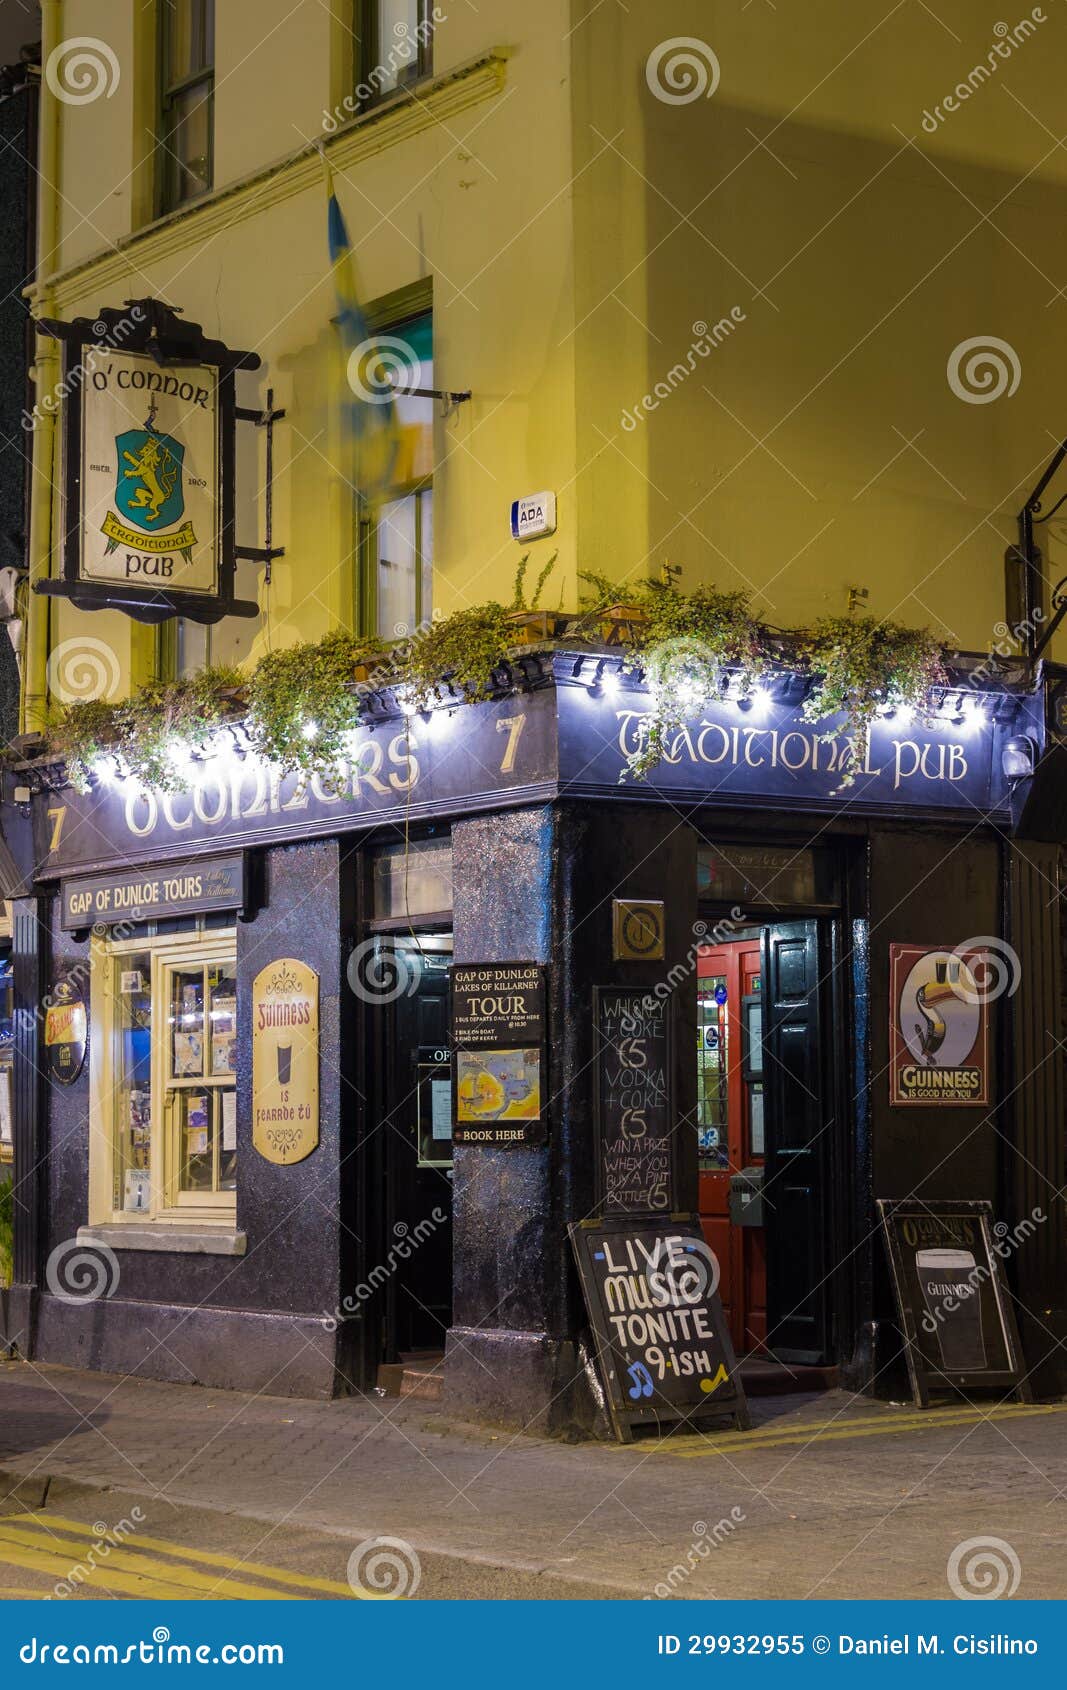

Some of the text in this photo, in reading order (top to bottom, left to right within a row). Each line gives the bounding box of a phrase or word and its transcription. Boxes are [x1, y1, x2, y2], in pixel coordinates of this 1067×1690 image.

[520, 507, 543, 523] ADA
[125, 554, 174, 577] PUB
[891, 739, 968, 790] PUB
[47, 805, 67, 853] 7
[496, 712, 526, 774] 7
[69, 876, 202, 914] GAP OF DUNLOE TOURS
[455, 968, 539, 983] GAP OF DUNLOE
[454, 981, 540, 993] LAKES OF KILLARNEY
[467, 996, 528, 1016] TOUR
[603, 998, 669, 1019] WHISKEY
[620, 1019, 665, 1039] COKE
[605, 1068, 667, 1089] VODKA
[902, 1066, 980, 1089] GUINNESS
[620, 1088, 665, 1110] COKE
[908, 1087, 972, 1098] IS GOOD FOR YOU
[463, 1129, 525, 1141] BOOK HERE
[602, 1138, 631, 1153] WIN
[633, 1138, 642, 1153] A
[604, 1156, 668, 1173] WHEN YOU
[631, 1171, 642, 1185] A
[602, 1235, 687, 1273] LIVE
[604, 1270, 703, 1313] MUSIC
[927, 1281, 976, 1297] GUINNESS
[609, 1308, 714, 1348] TONITE
